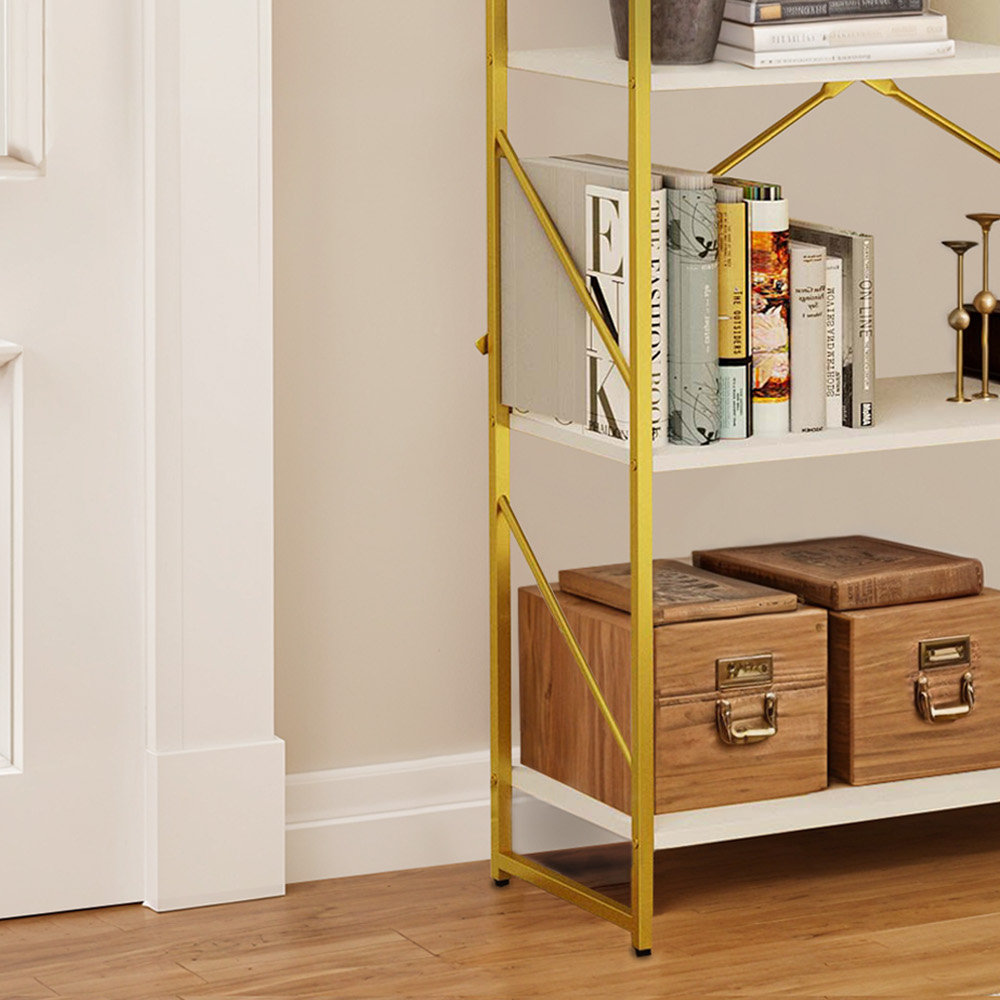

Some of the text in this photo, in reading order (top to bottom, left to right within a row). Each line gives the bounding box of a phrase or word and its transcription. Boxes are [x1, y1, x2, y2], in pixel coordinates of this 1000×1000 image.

[587, 194, 624, 278] E
[859, 280, 873, 300] ON
[733, 291, 743, 354] THE OUTSIDERS
[859, 307, 873, 338] LINE
